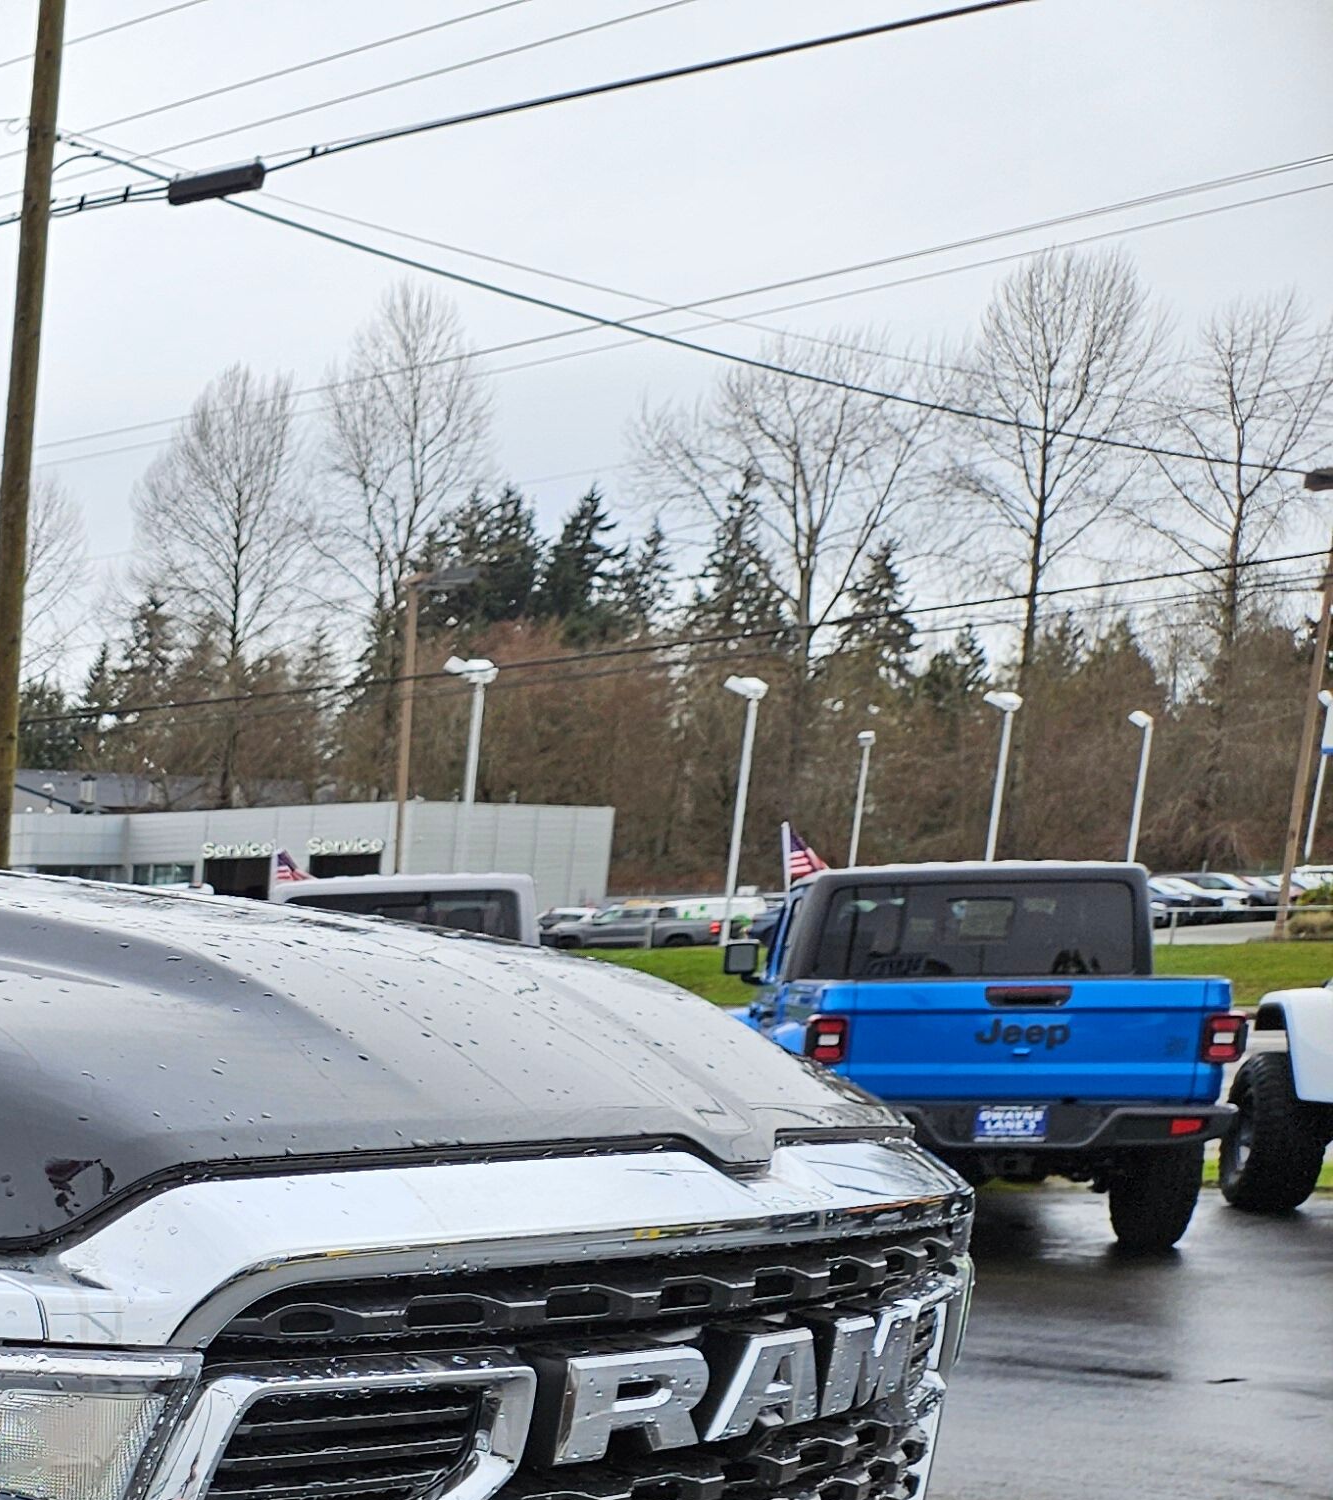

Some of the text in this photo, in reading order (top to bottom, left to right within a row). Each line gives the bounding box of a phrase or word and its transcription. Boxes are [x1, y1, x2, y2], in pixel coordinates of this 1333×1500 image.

[202, 841, 273, 858] Service
[305, 836, 385, 854] Service
[975, 1018, 1071, 1049] Jeep
[553, 1300, 920, 1466] RAM
